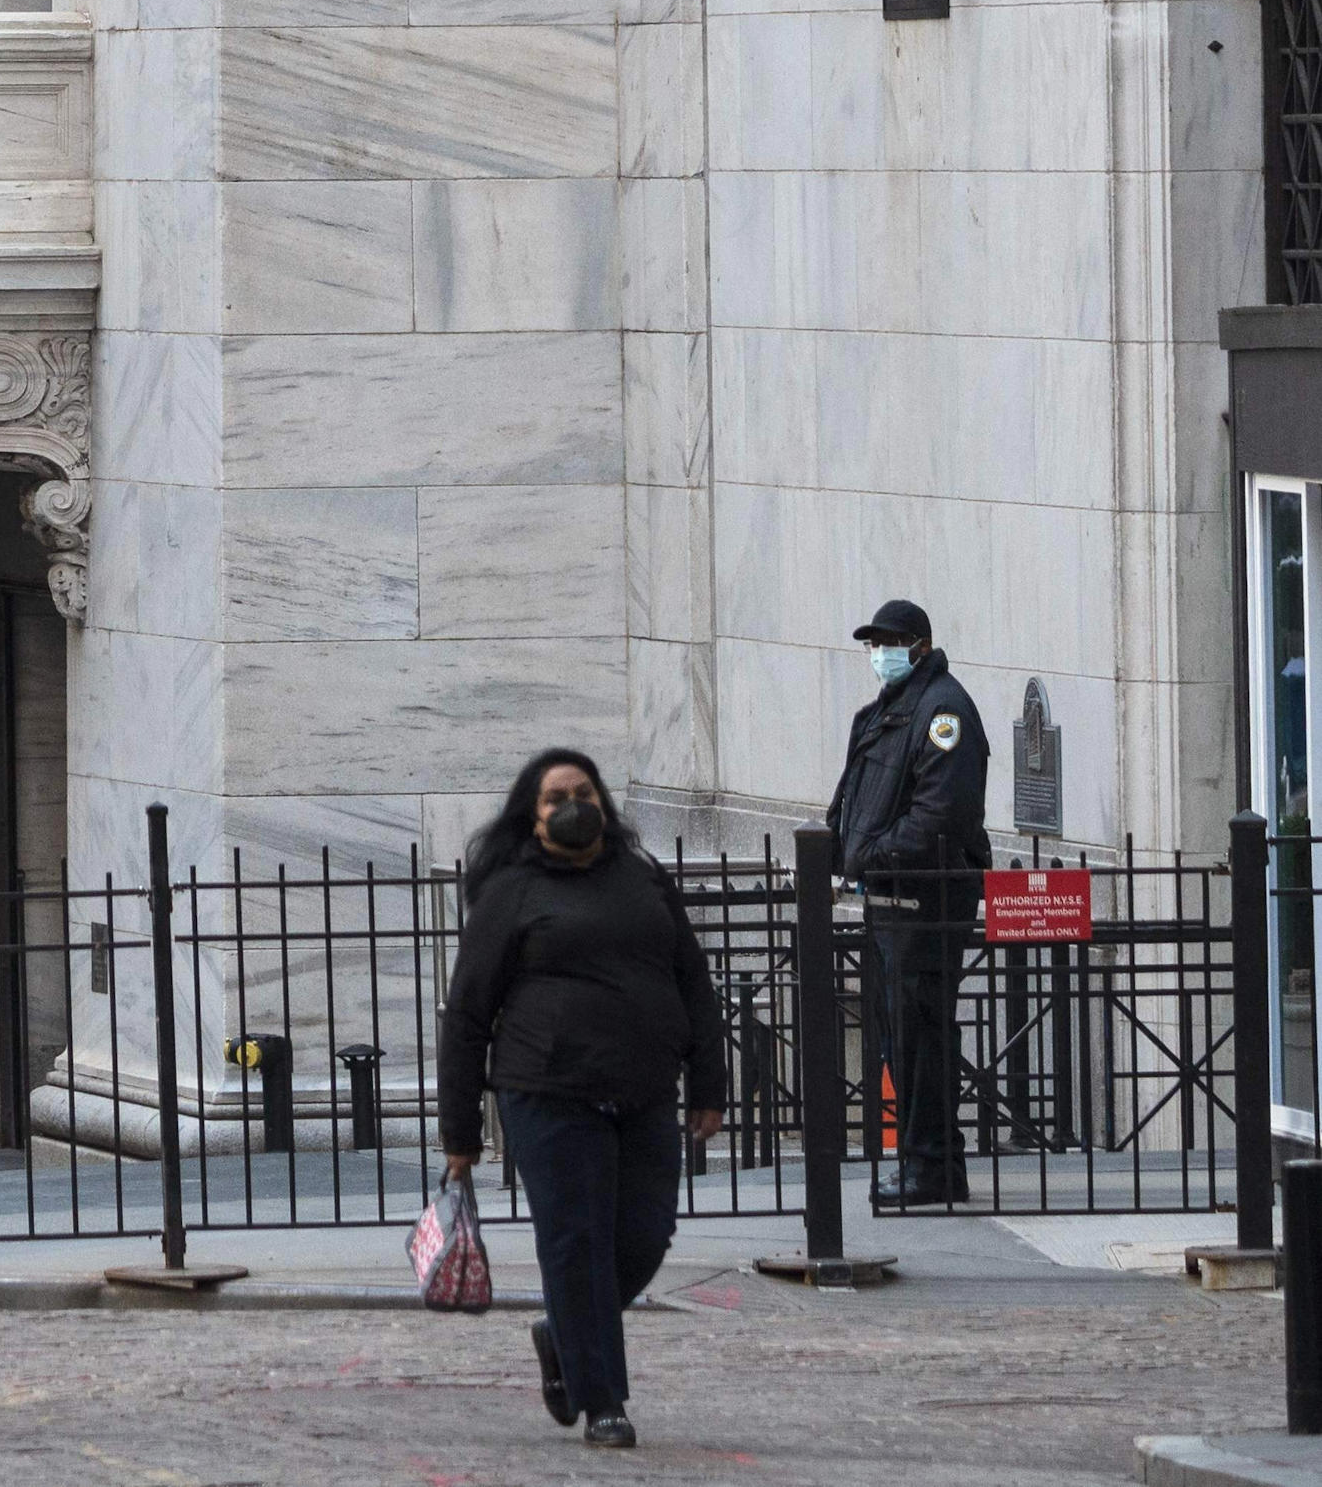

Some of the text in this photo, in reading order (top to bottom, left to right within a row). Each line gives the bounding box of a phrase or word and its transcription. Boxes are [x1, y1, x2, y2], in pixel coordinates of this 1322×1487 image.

[992, 895, 1084, 906] AUTHORIZED N.Y.S.E.
[996, 907, 1080, 917] Employees, Members
[1030, 918, 1047, 927] and
[997, 927, 1080, 937] Invited Guests ONLY.
